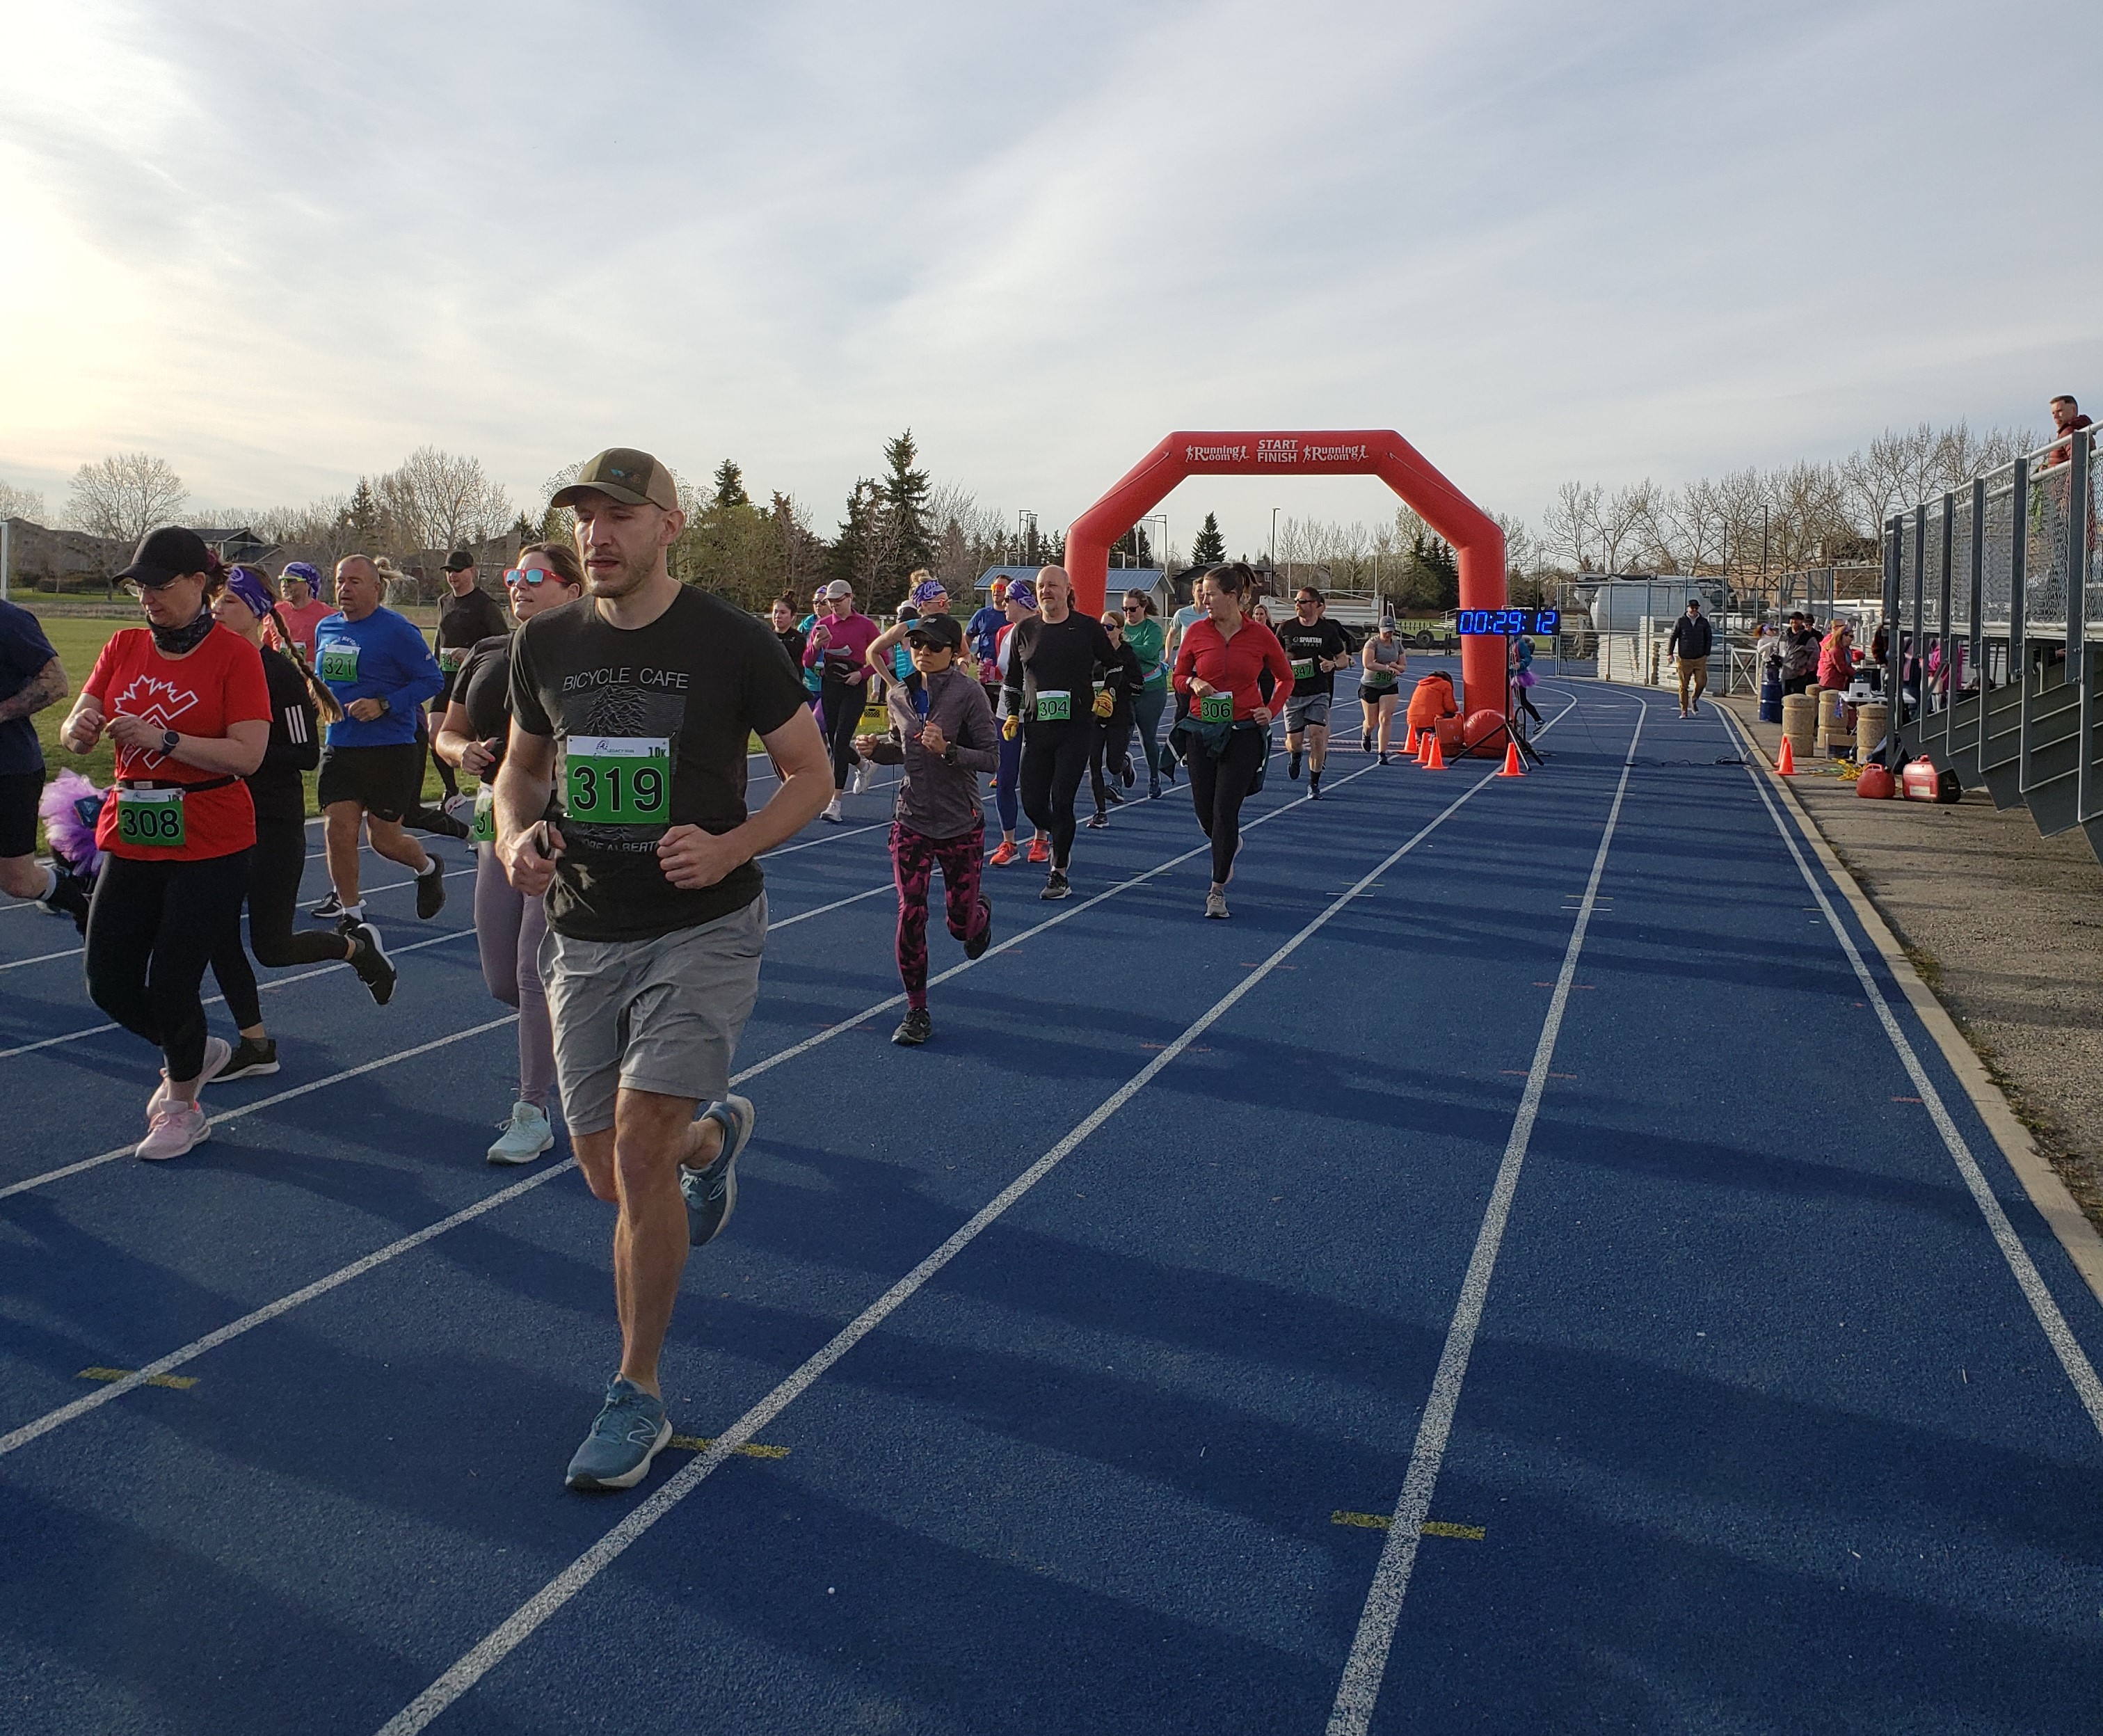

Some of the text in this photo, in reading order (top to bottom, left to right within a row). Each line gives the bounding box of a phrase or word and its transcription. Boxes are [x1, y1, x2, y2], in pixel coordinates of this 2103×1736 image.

[1258, 439, 1299, 449] START
[1194, 445, 1240, 461] Running
[1257, 452, 1297, 463] FINISH
[1311, 445, 1359, 461] Running
[324, 657, 353, 676] 321
[1293, 664, 1312, 676] 347
[562, 667, 690, 692] BICYCLE CAFE
[1039, 700, 1069, 717] 304
[1202, 701, 1231, 719] 306
[573, 765, 664, 813] 319
[120, 807, 181, 839] 308
